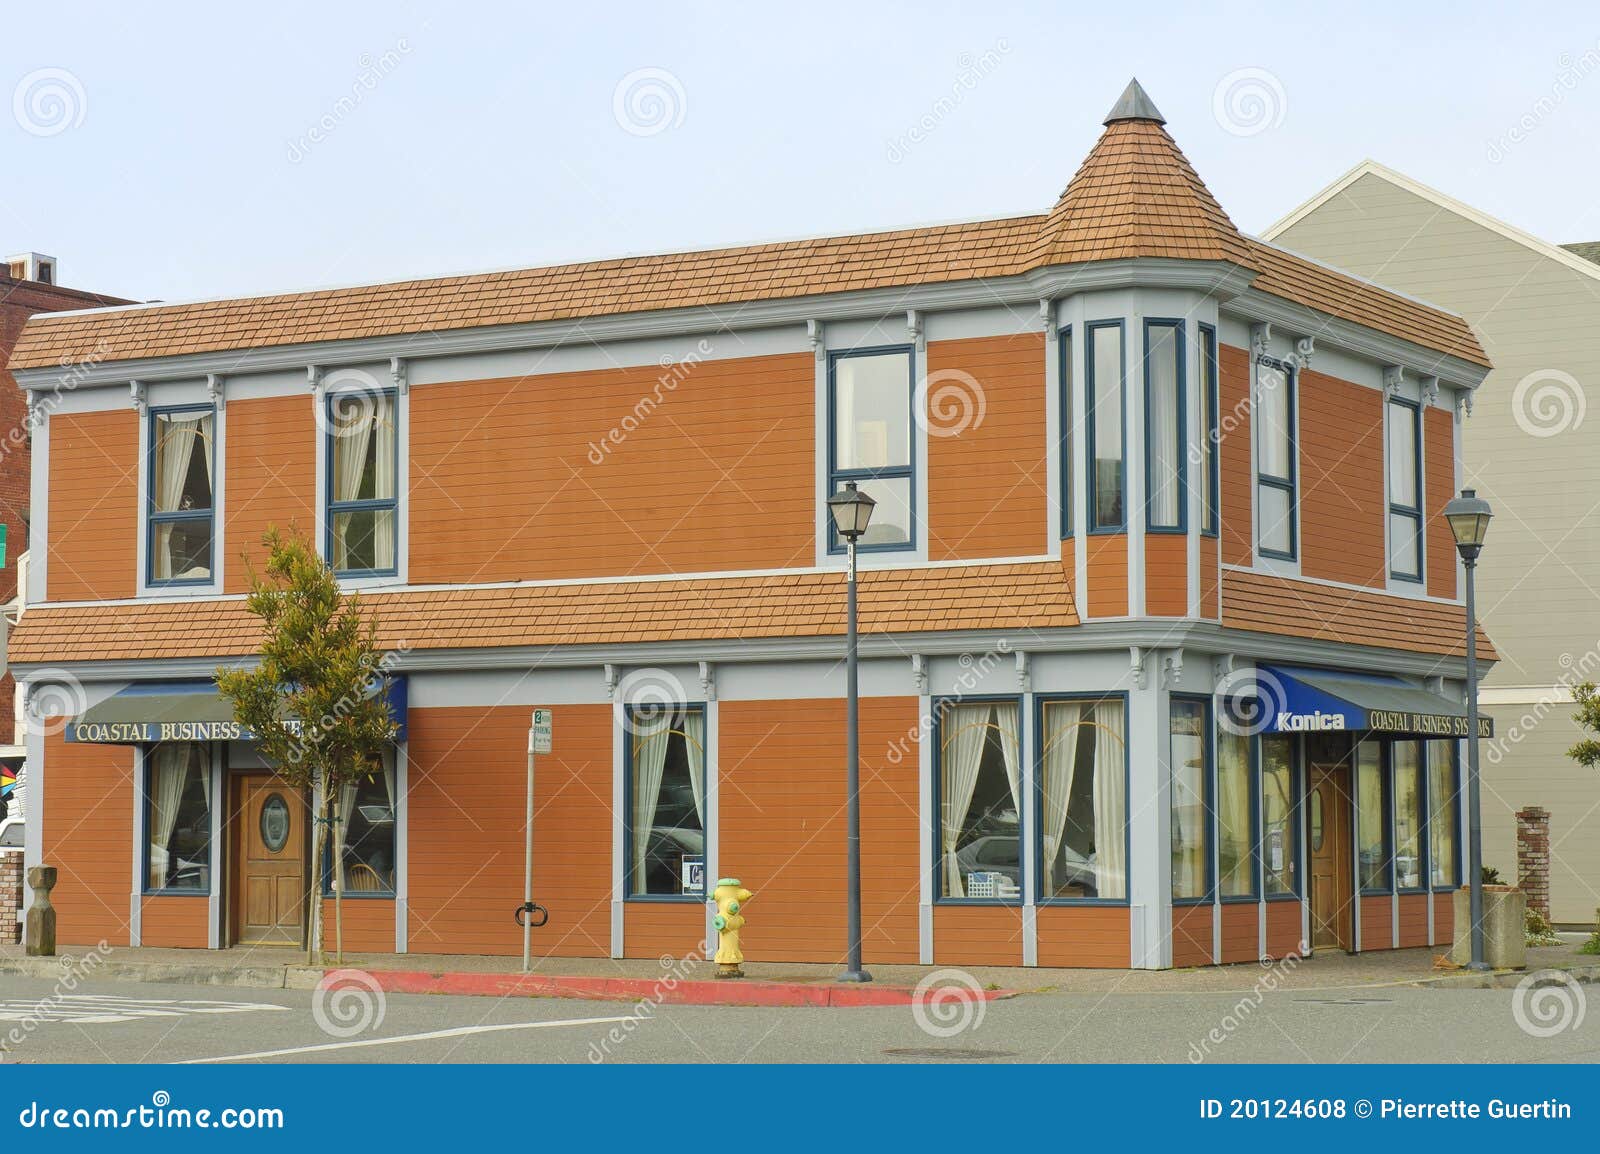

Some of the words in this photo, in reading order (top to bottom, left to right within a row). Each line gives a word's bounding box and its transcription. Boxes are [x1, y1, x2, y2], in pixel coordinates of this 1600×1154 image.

[76, 723, 152, 741] COASTAL
[160, 721, 241, 741] BUSINESS
[1277, 710, 1344, 732] Konica
[1370, 710, 1410, 732] COASTAL
[1413, 714, 1452, 735] BUSINESS
[1454, 717, 1490, 737] SYSMS
